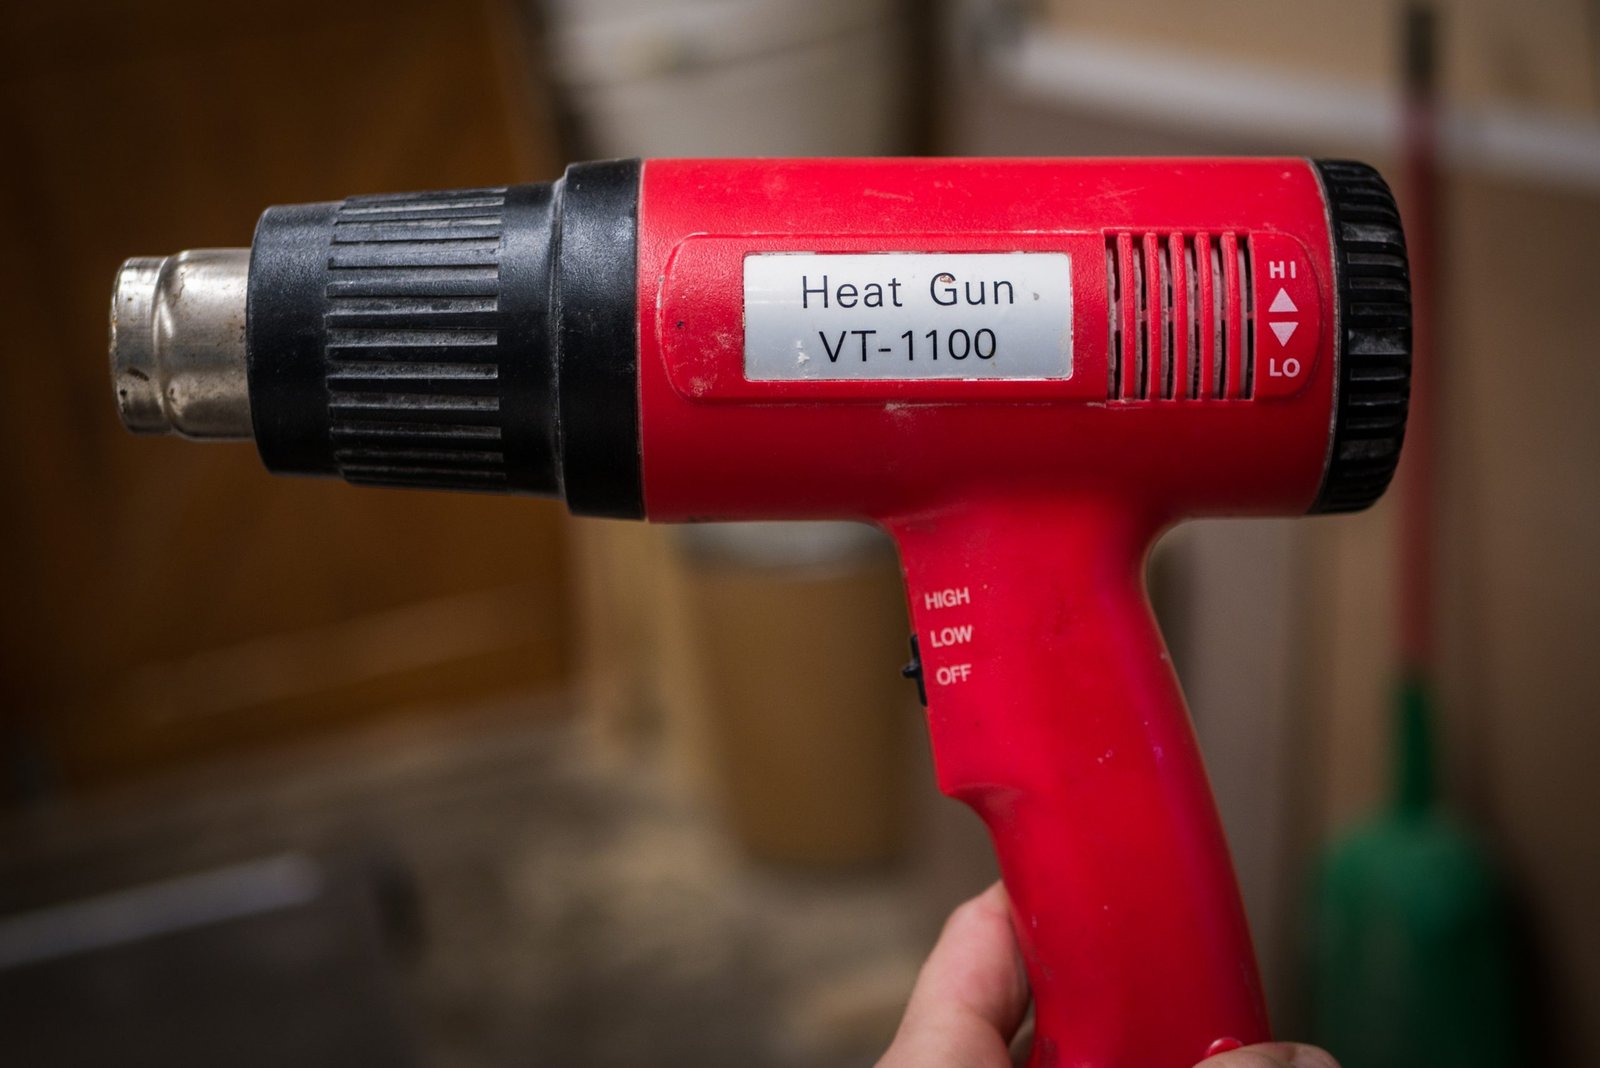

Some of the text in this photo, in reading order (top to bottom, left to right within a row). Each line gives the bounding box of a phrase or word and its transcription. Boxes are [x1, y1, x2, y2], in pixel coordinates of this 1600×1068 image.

[1269, 260, 1297, 279] HI
[802, 272, 1014, 309] Heat Gun
[818, 328, 997, 363] VT-1100
[1269, 358, 1301, 378] LO
[925, 587, 970, 609] HIGH
[930, 625, 973, 647] LOW
[936, 664, 972, 685] OFF
